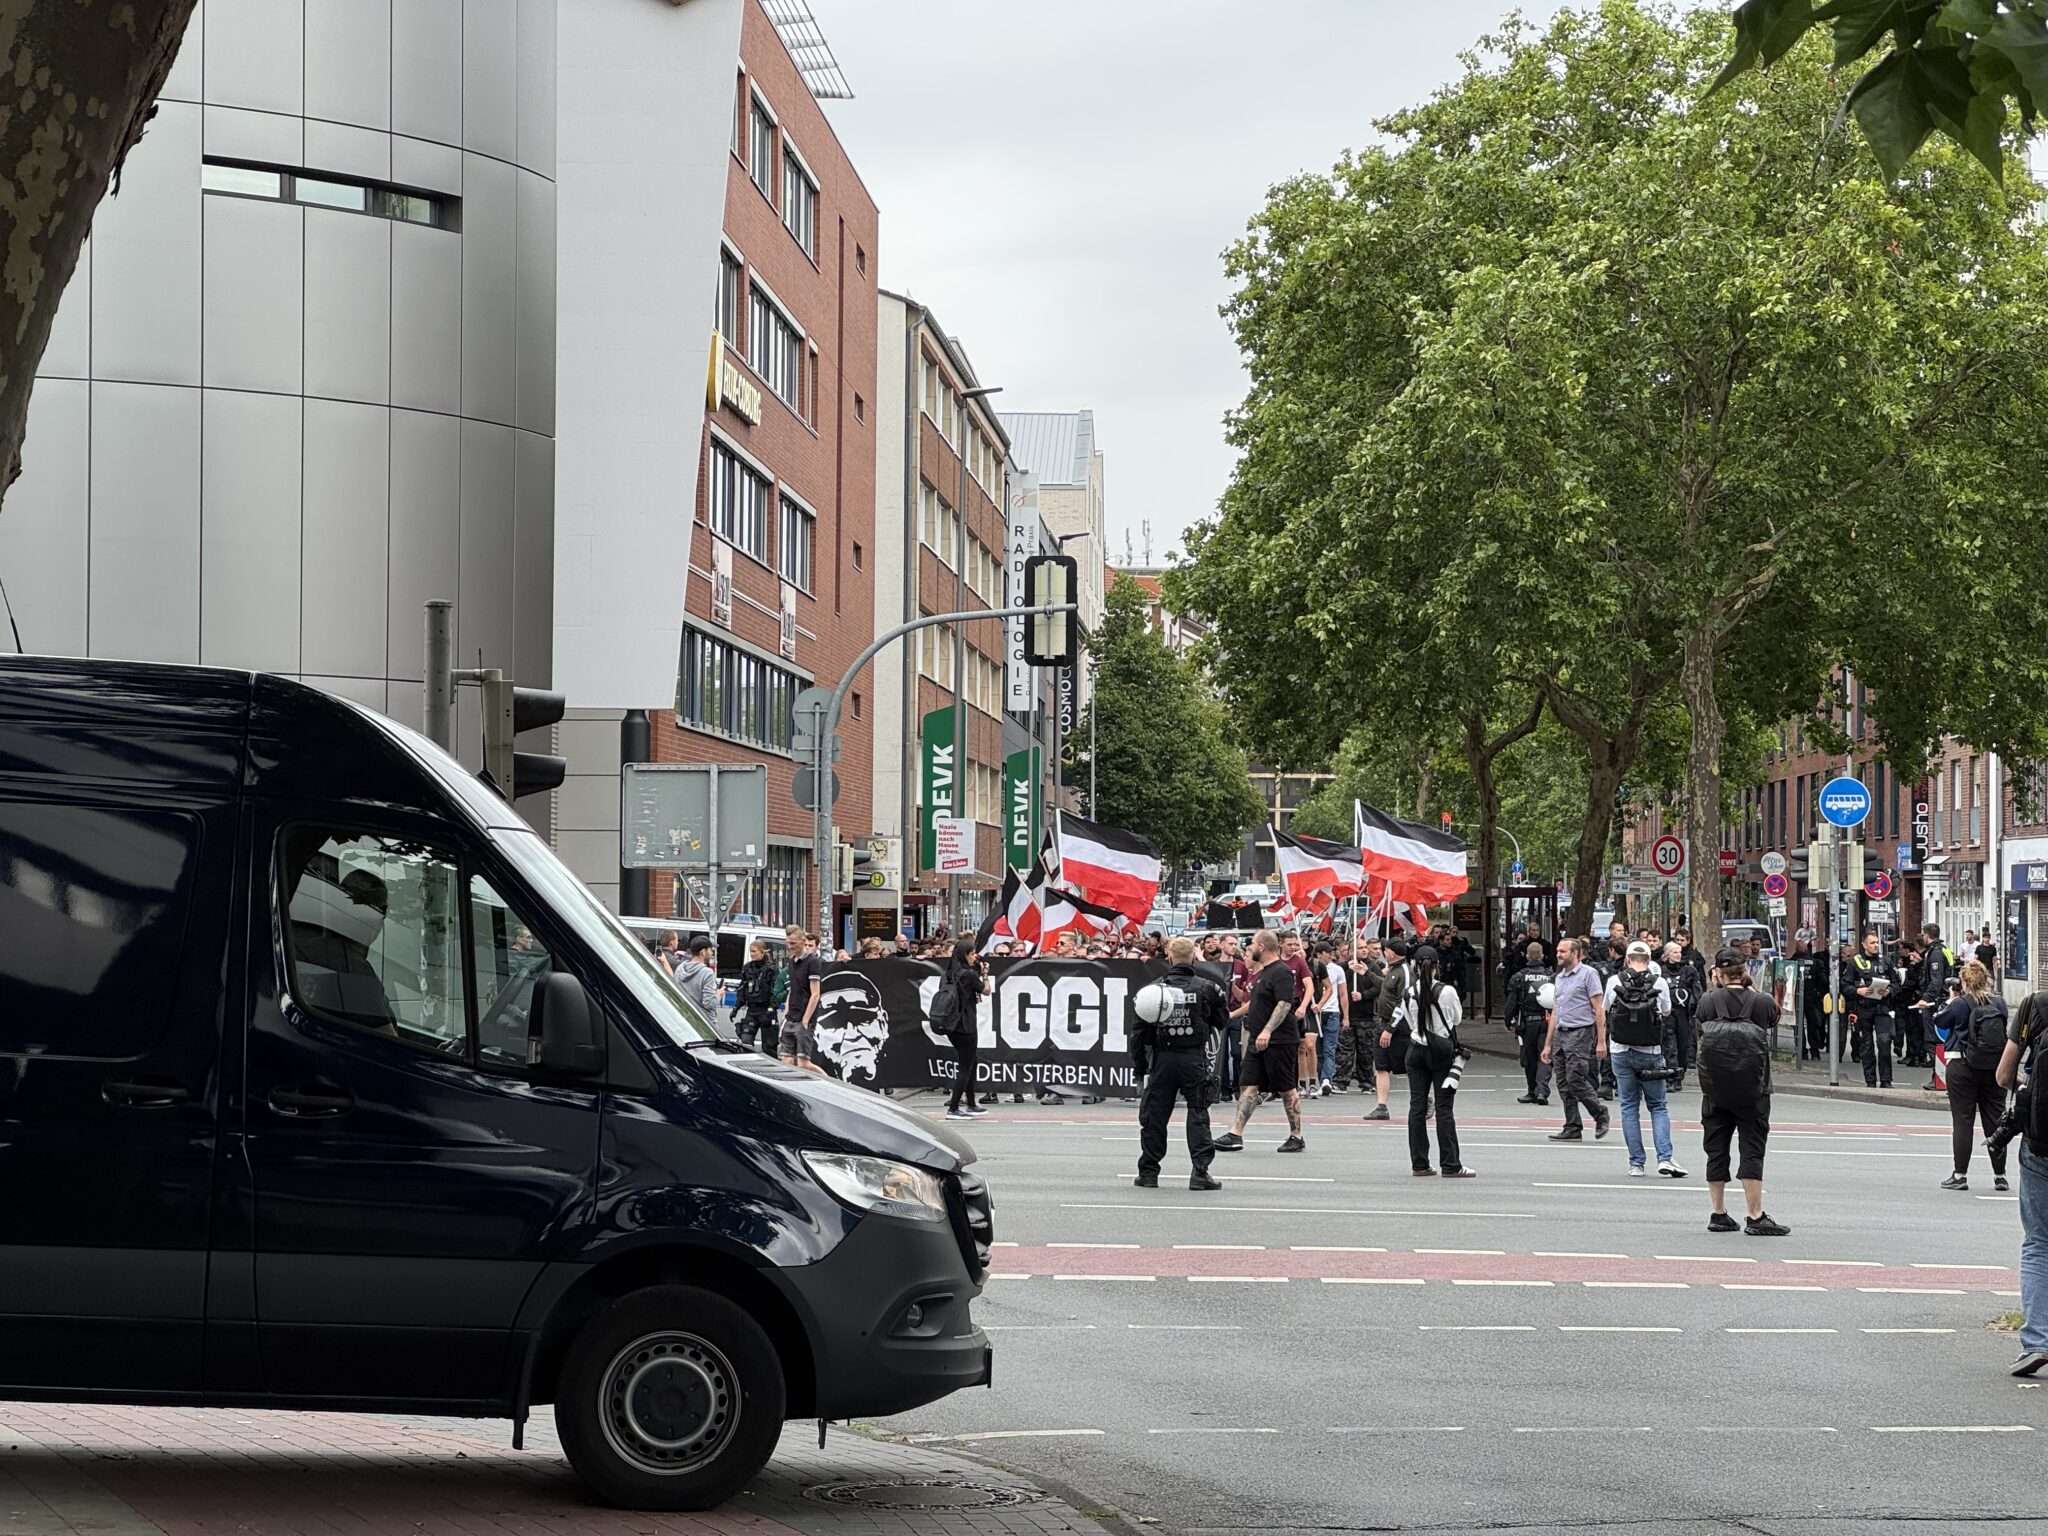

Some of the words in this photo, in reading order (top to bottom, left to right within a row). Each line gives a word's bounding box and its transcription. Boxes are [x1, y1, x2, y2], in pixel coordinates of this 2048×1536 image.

[1013, 525, 1025, 696] RADIOLOGIE
[932, 743, 953, 830] DEVK
[1013, 778, 1028, 846] DEVK
[1659, 847, 1678, 864] 30
[928, 1058, 1017, 1082] LEGEDEN
[1023, 1063, 1103, 1086] STERBEN
